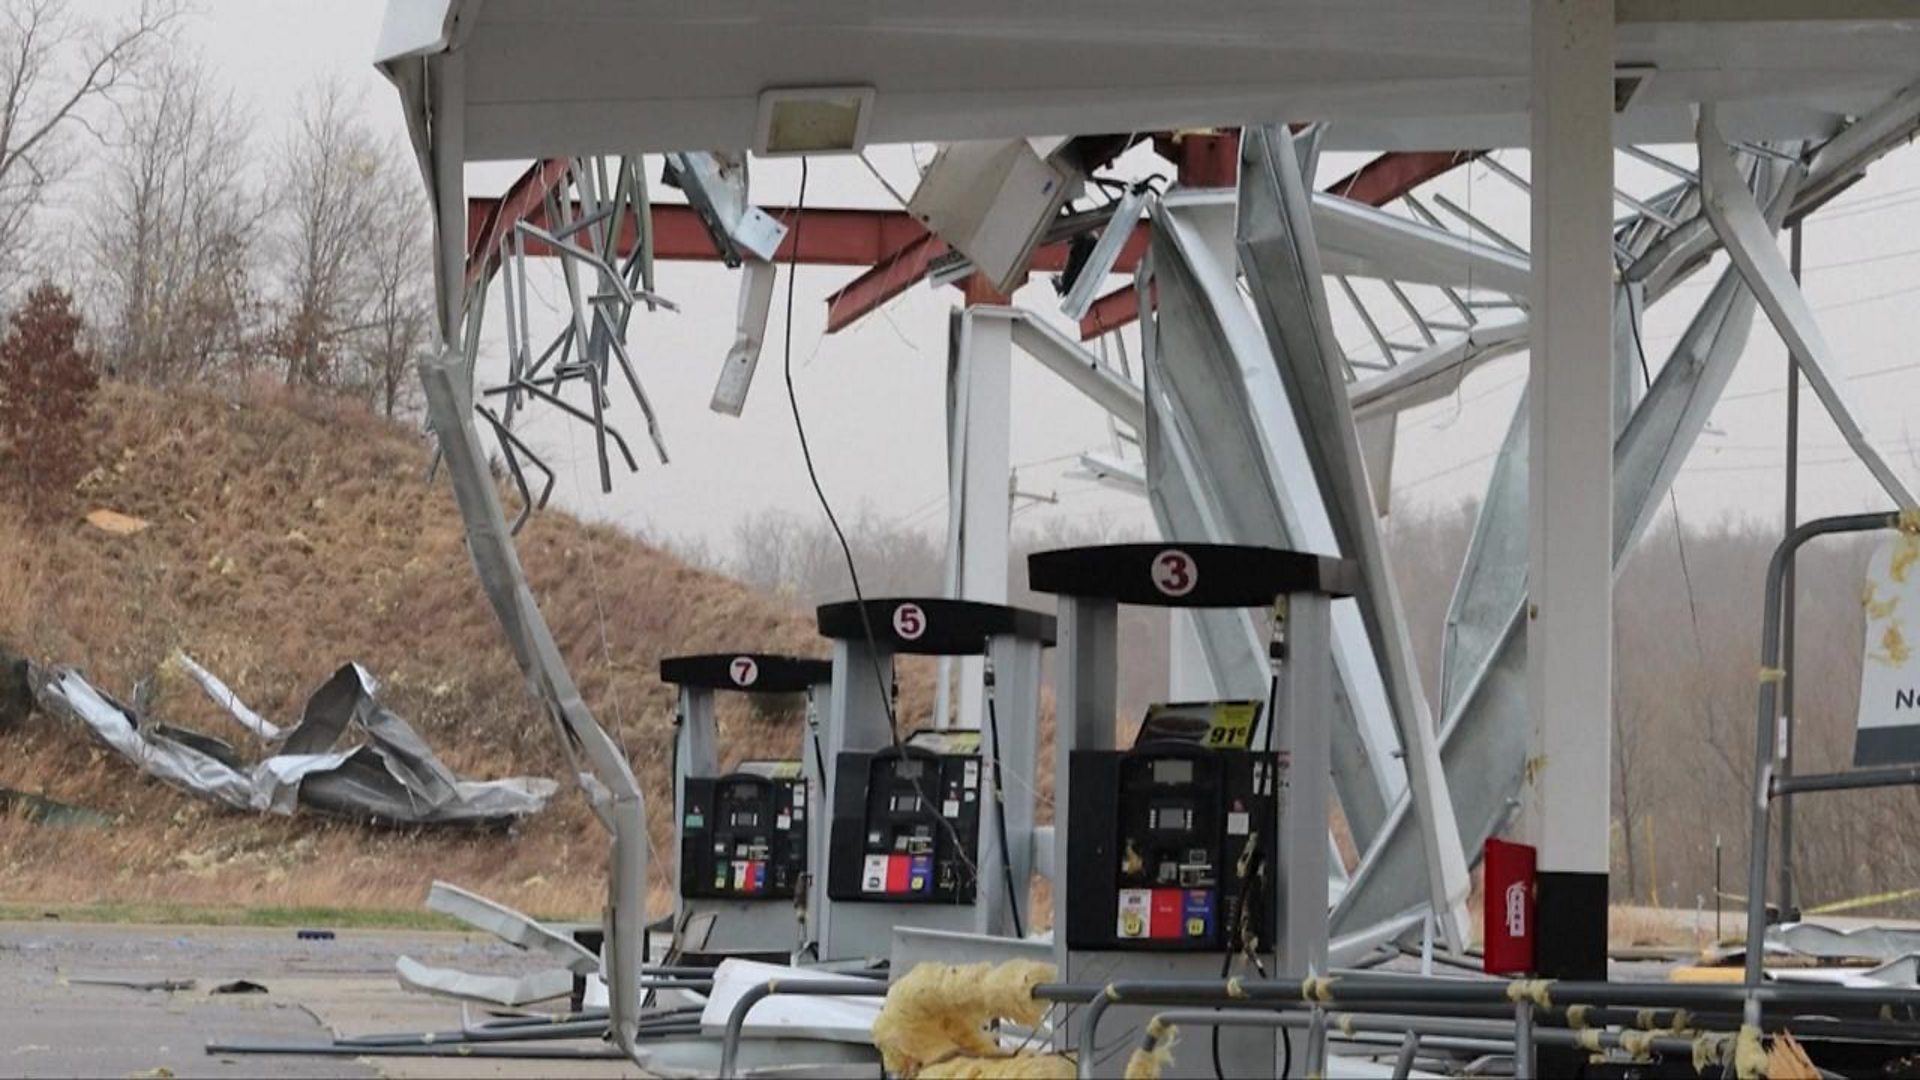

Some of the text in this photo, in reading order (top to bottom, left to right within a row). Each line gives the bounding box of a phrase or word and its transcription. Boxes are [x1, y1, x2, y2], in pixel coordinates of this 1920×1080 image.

[1161, 555, 1189, 591] 3
[901, 608, 920, 634] 5
[735, 661, 752, 682] 7
[1895, 689, 1920, 710] N
